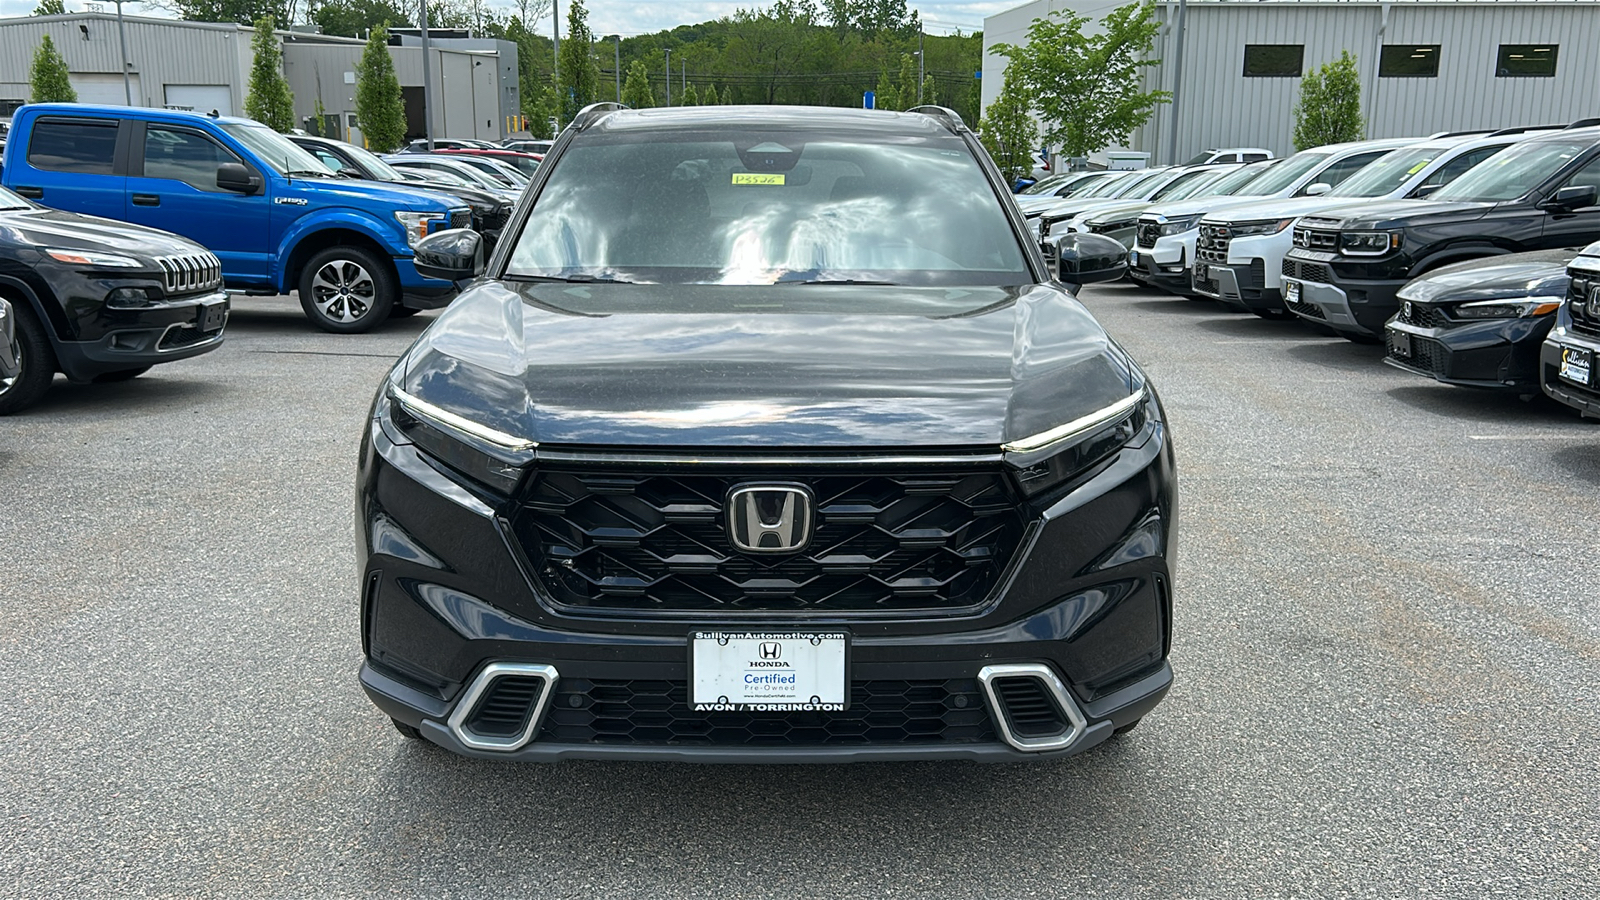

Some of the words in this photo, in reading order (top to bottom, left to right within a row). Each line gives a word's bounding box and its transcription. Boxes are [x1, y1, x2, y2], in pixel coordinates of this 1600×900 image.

[695, 632, 845, 640] SullivanAutomotive.com
[744, 673, 796, 684] Certified
[694, 703, 736, 712] AVON
[739, 703, 744, 712] /
[747, 703, 845, 712] TORRINGTON
